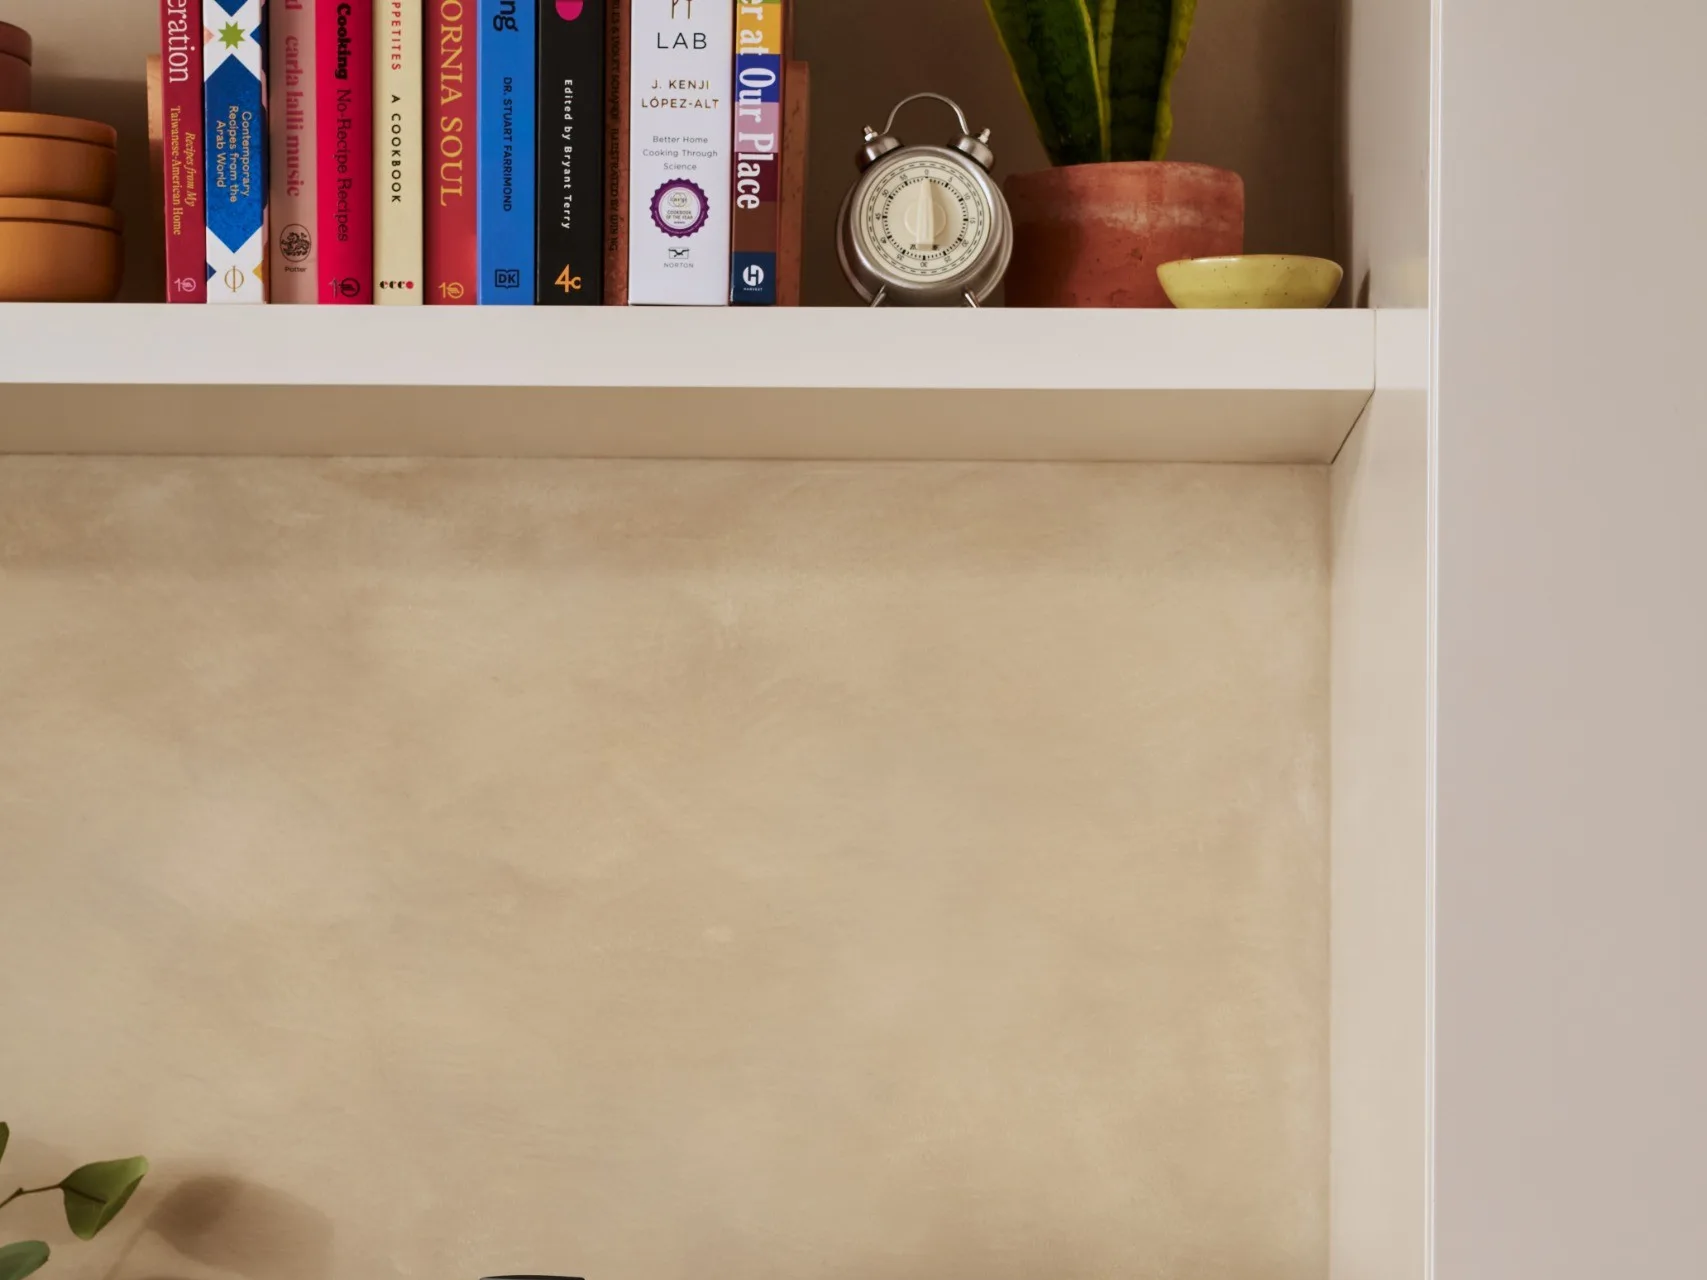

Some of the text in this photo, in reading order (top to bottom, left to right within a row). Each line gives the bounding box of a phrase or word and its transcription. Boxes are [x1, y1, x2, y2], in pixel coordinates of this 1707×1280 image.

[285, 35, 304, 87] carla
[657, 31, 708, 50] LAB
[286, 91, 304, 131] lalli
[391, 94, 401, 104] A
[440, 0, 463, 207] ORNIA SOUL
[641, 96, 720, 109] LÓPEZ-ALT
[651, 79, 710, 90] J. KENJI
[736, 0, 776, 209] r at Our Place
[216, 120, 226, 188] Arab World
[228, 105, 239, 203] Recipes from the
[240, 111, 253, 196] Contemporary
[332, 3, 353, 242] Cooking No-Recipe Recipes
[503, 76, 513, 212] DR. STUART FARRIMOND
[561, 79, 573, 229] Edited by Bryant Terry
[642, 148, 718, 159] Cooking Through
[652, 135, 709, 144] Better Home
[170, 105, 184, 236] Taiwanese-American Home
[184, 132, 197, 207] Recipes from My
[286, 135, 305, 197] music
[391, 113, 402, 203] COOKBOOK
[663, 162, 698, 171] Science
[498, 273, 517, 284] DK
